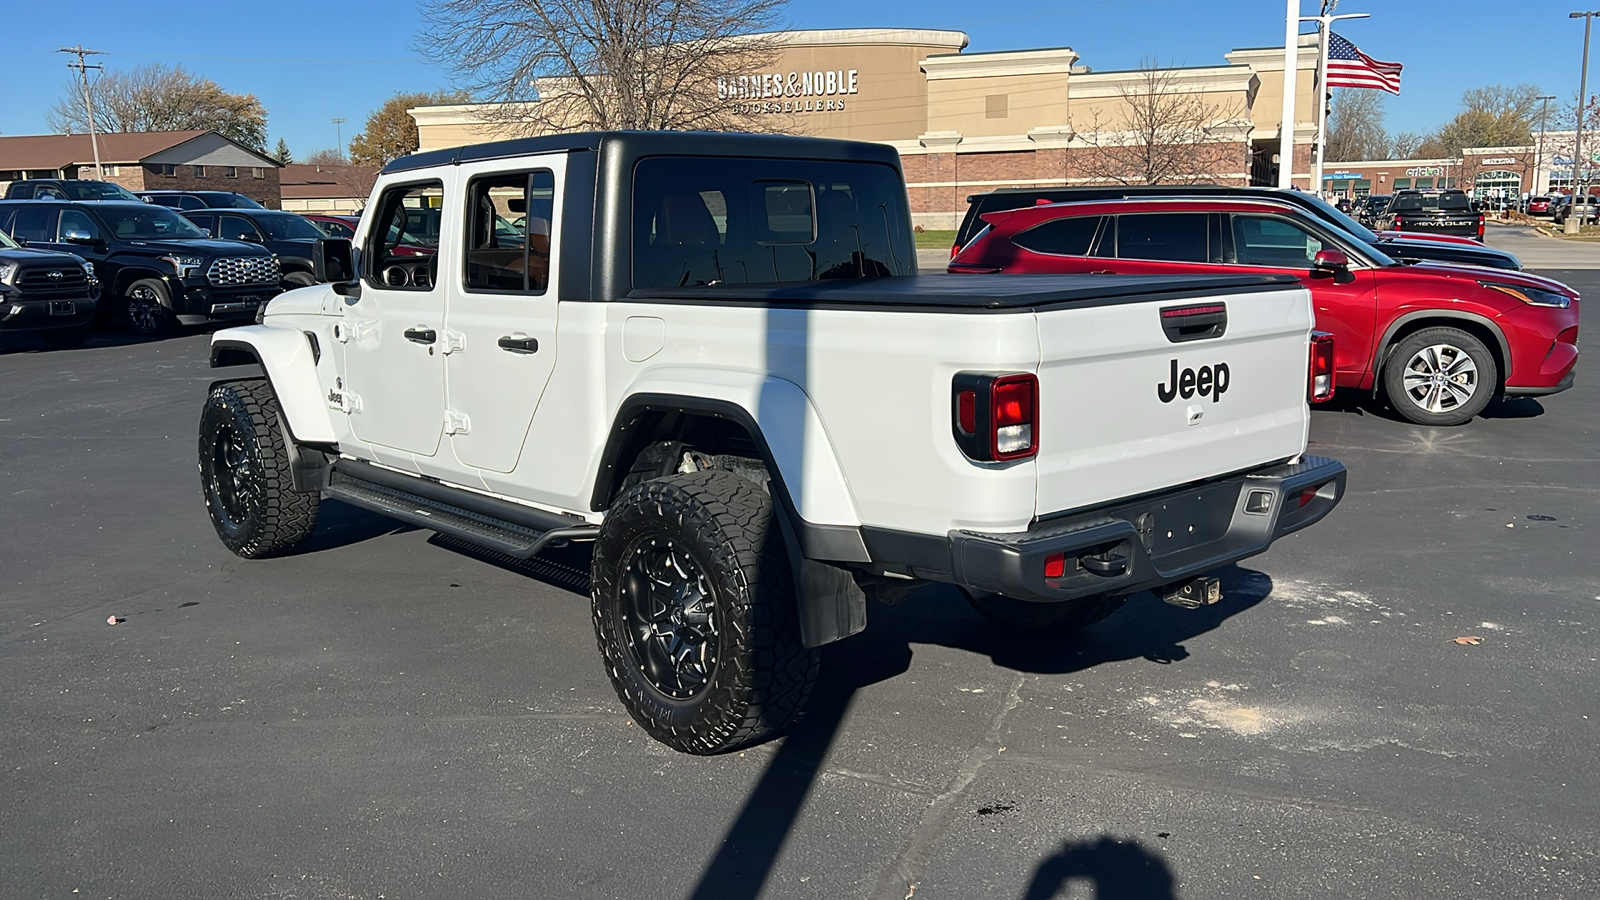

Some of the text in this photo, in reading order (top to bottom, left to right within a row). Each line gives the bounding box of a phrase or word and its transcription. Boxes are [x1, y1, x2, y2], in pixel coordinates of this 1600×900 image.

[732, 99, 845, 114] BOOKSELLERS
[1406, 166, 1443, 177] cricket
[1157, 358, 1230, 403] Jeep
[328, 388, 343, 407] Jeep
